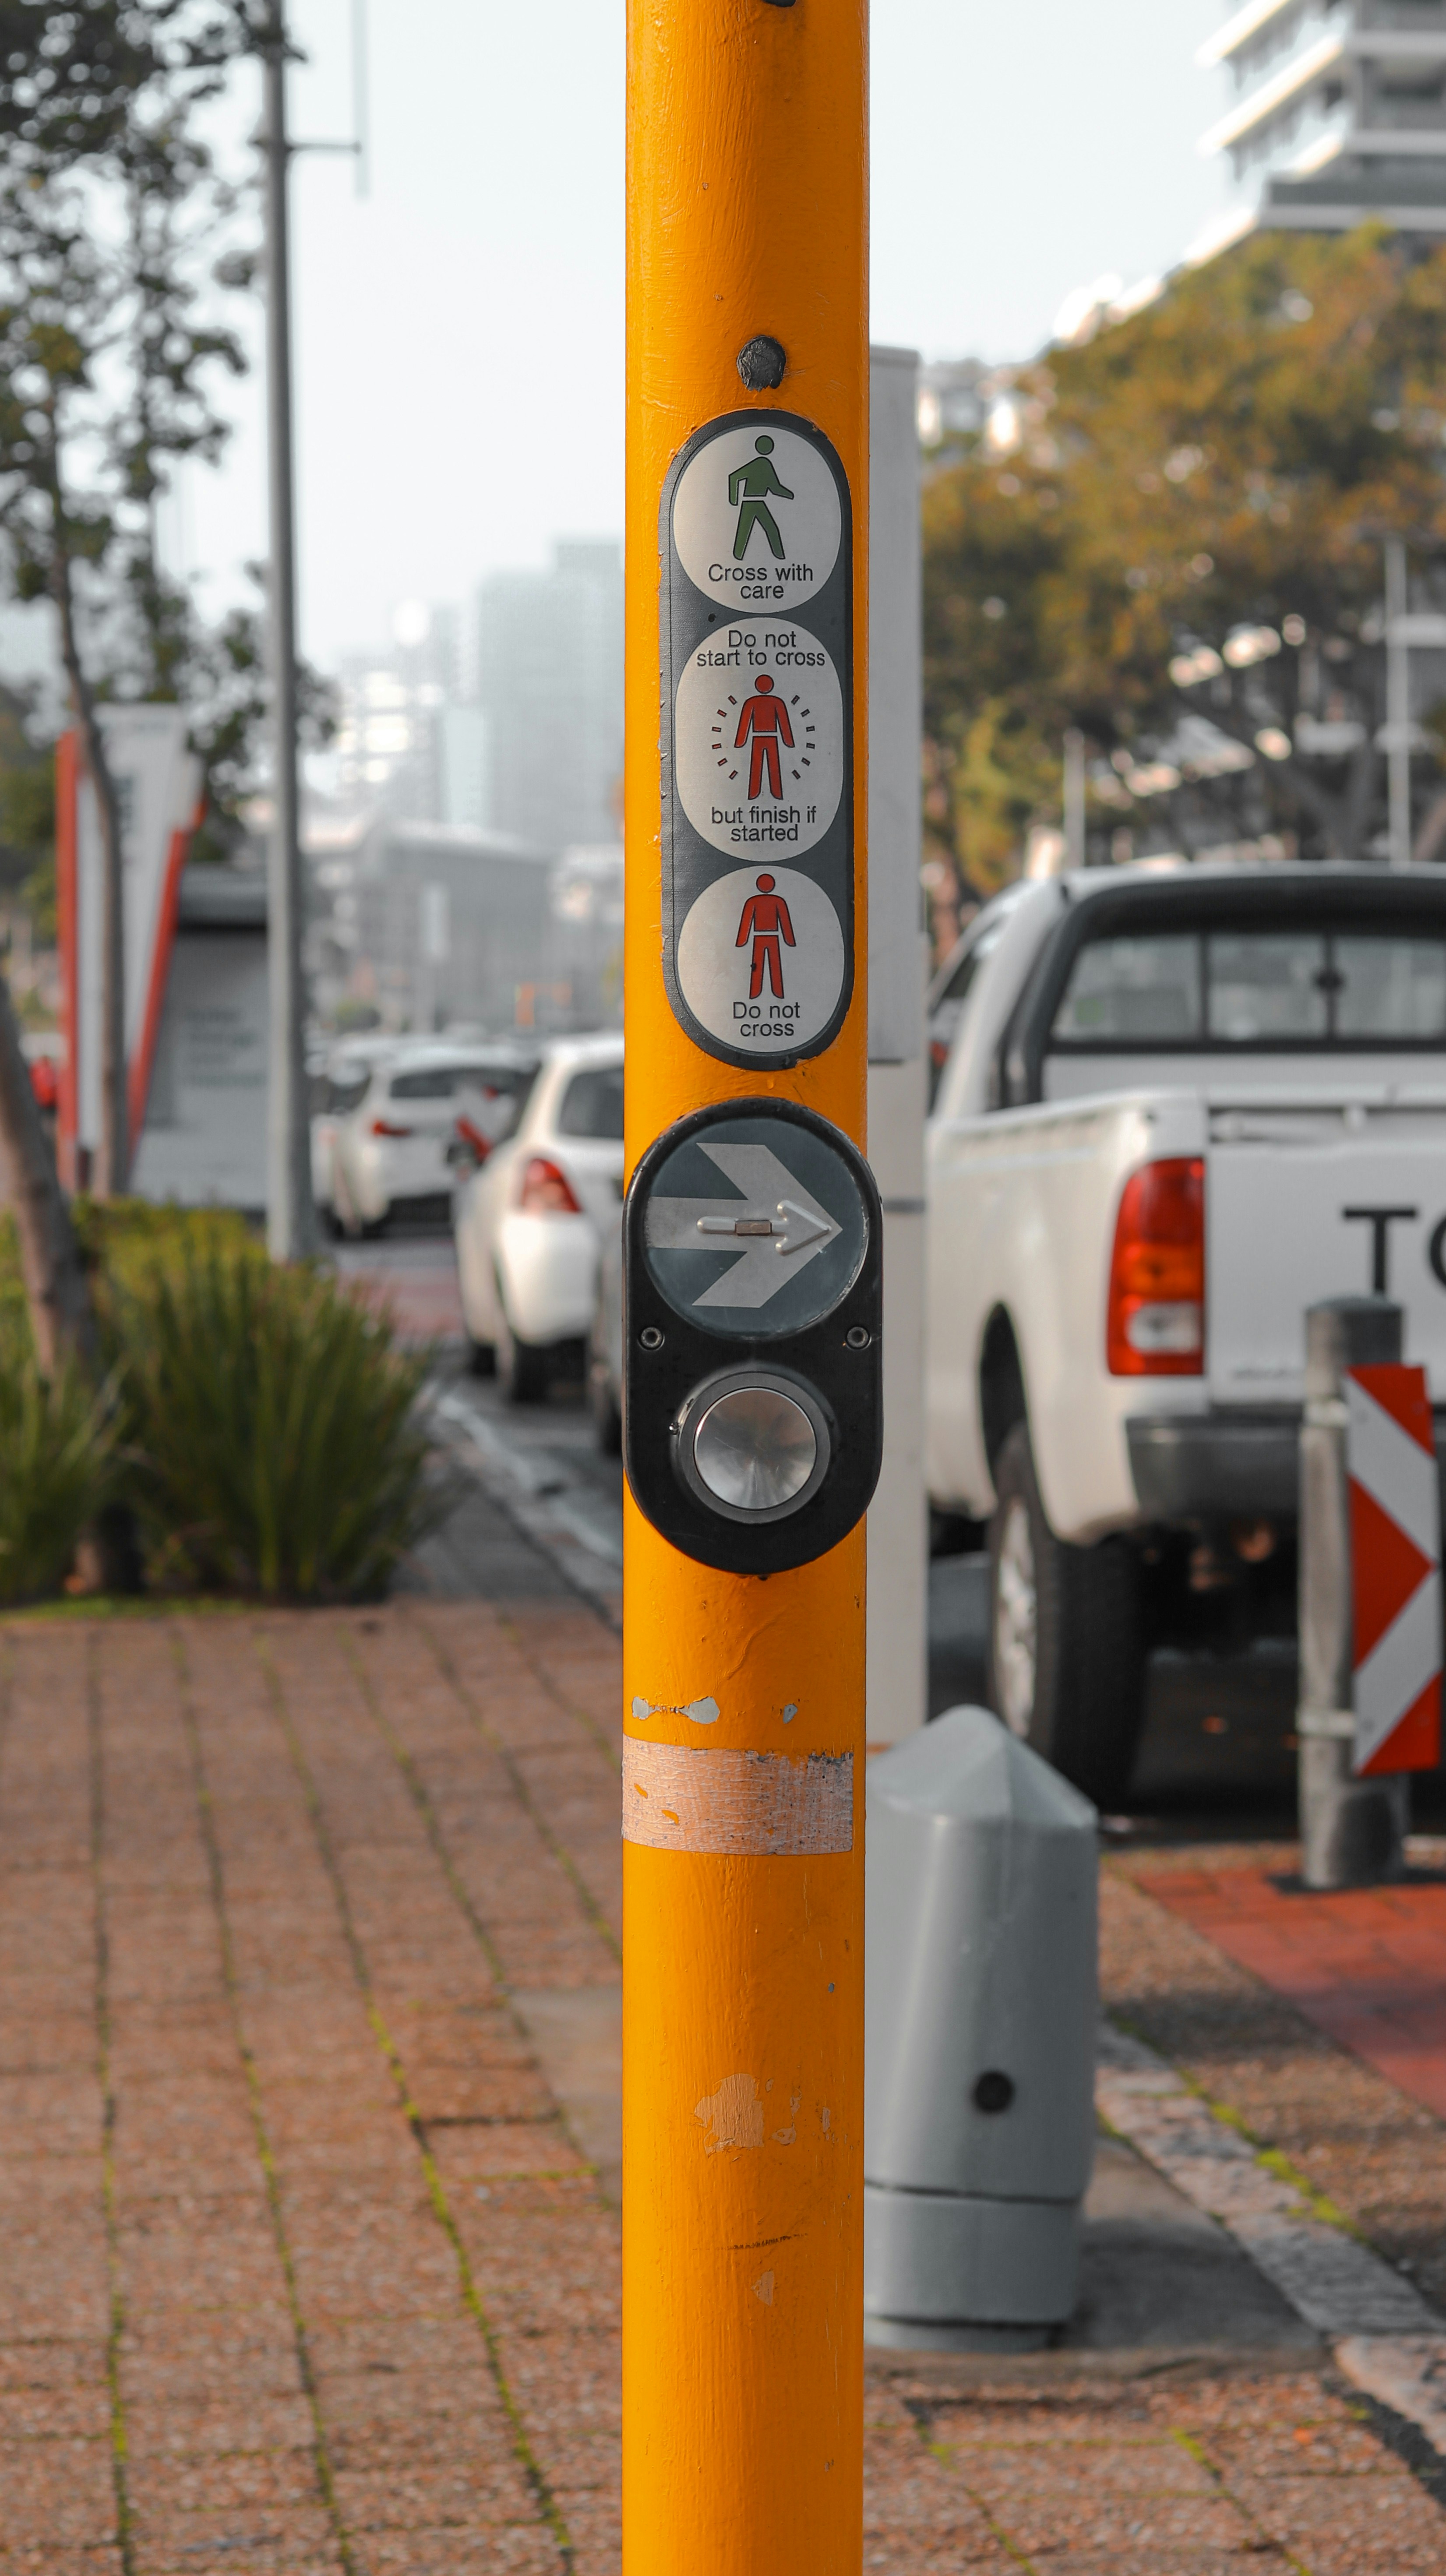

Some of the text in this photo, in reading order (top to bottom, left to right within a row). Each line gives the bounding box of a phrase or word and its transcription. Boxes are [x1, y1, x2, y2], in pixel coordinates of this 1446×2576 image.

[708, 563, 813, 582] Cross with
[740, 585, 784, 600] care
[728, 630, 797, 648] Do not
[696, 649, 825, 667] start to cross
[711, 805, 817, 824] but finish if
[730, 824, 798, 842] started
[733, 1002, 801, 1019] Do not
[740, 1023, 795, 1037] cross
[1344, 1207, 1446, 1293] T
